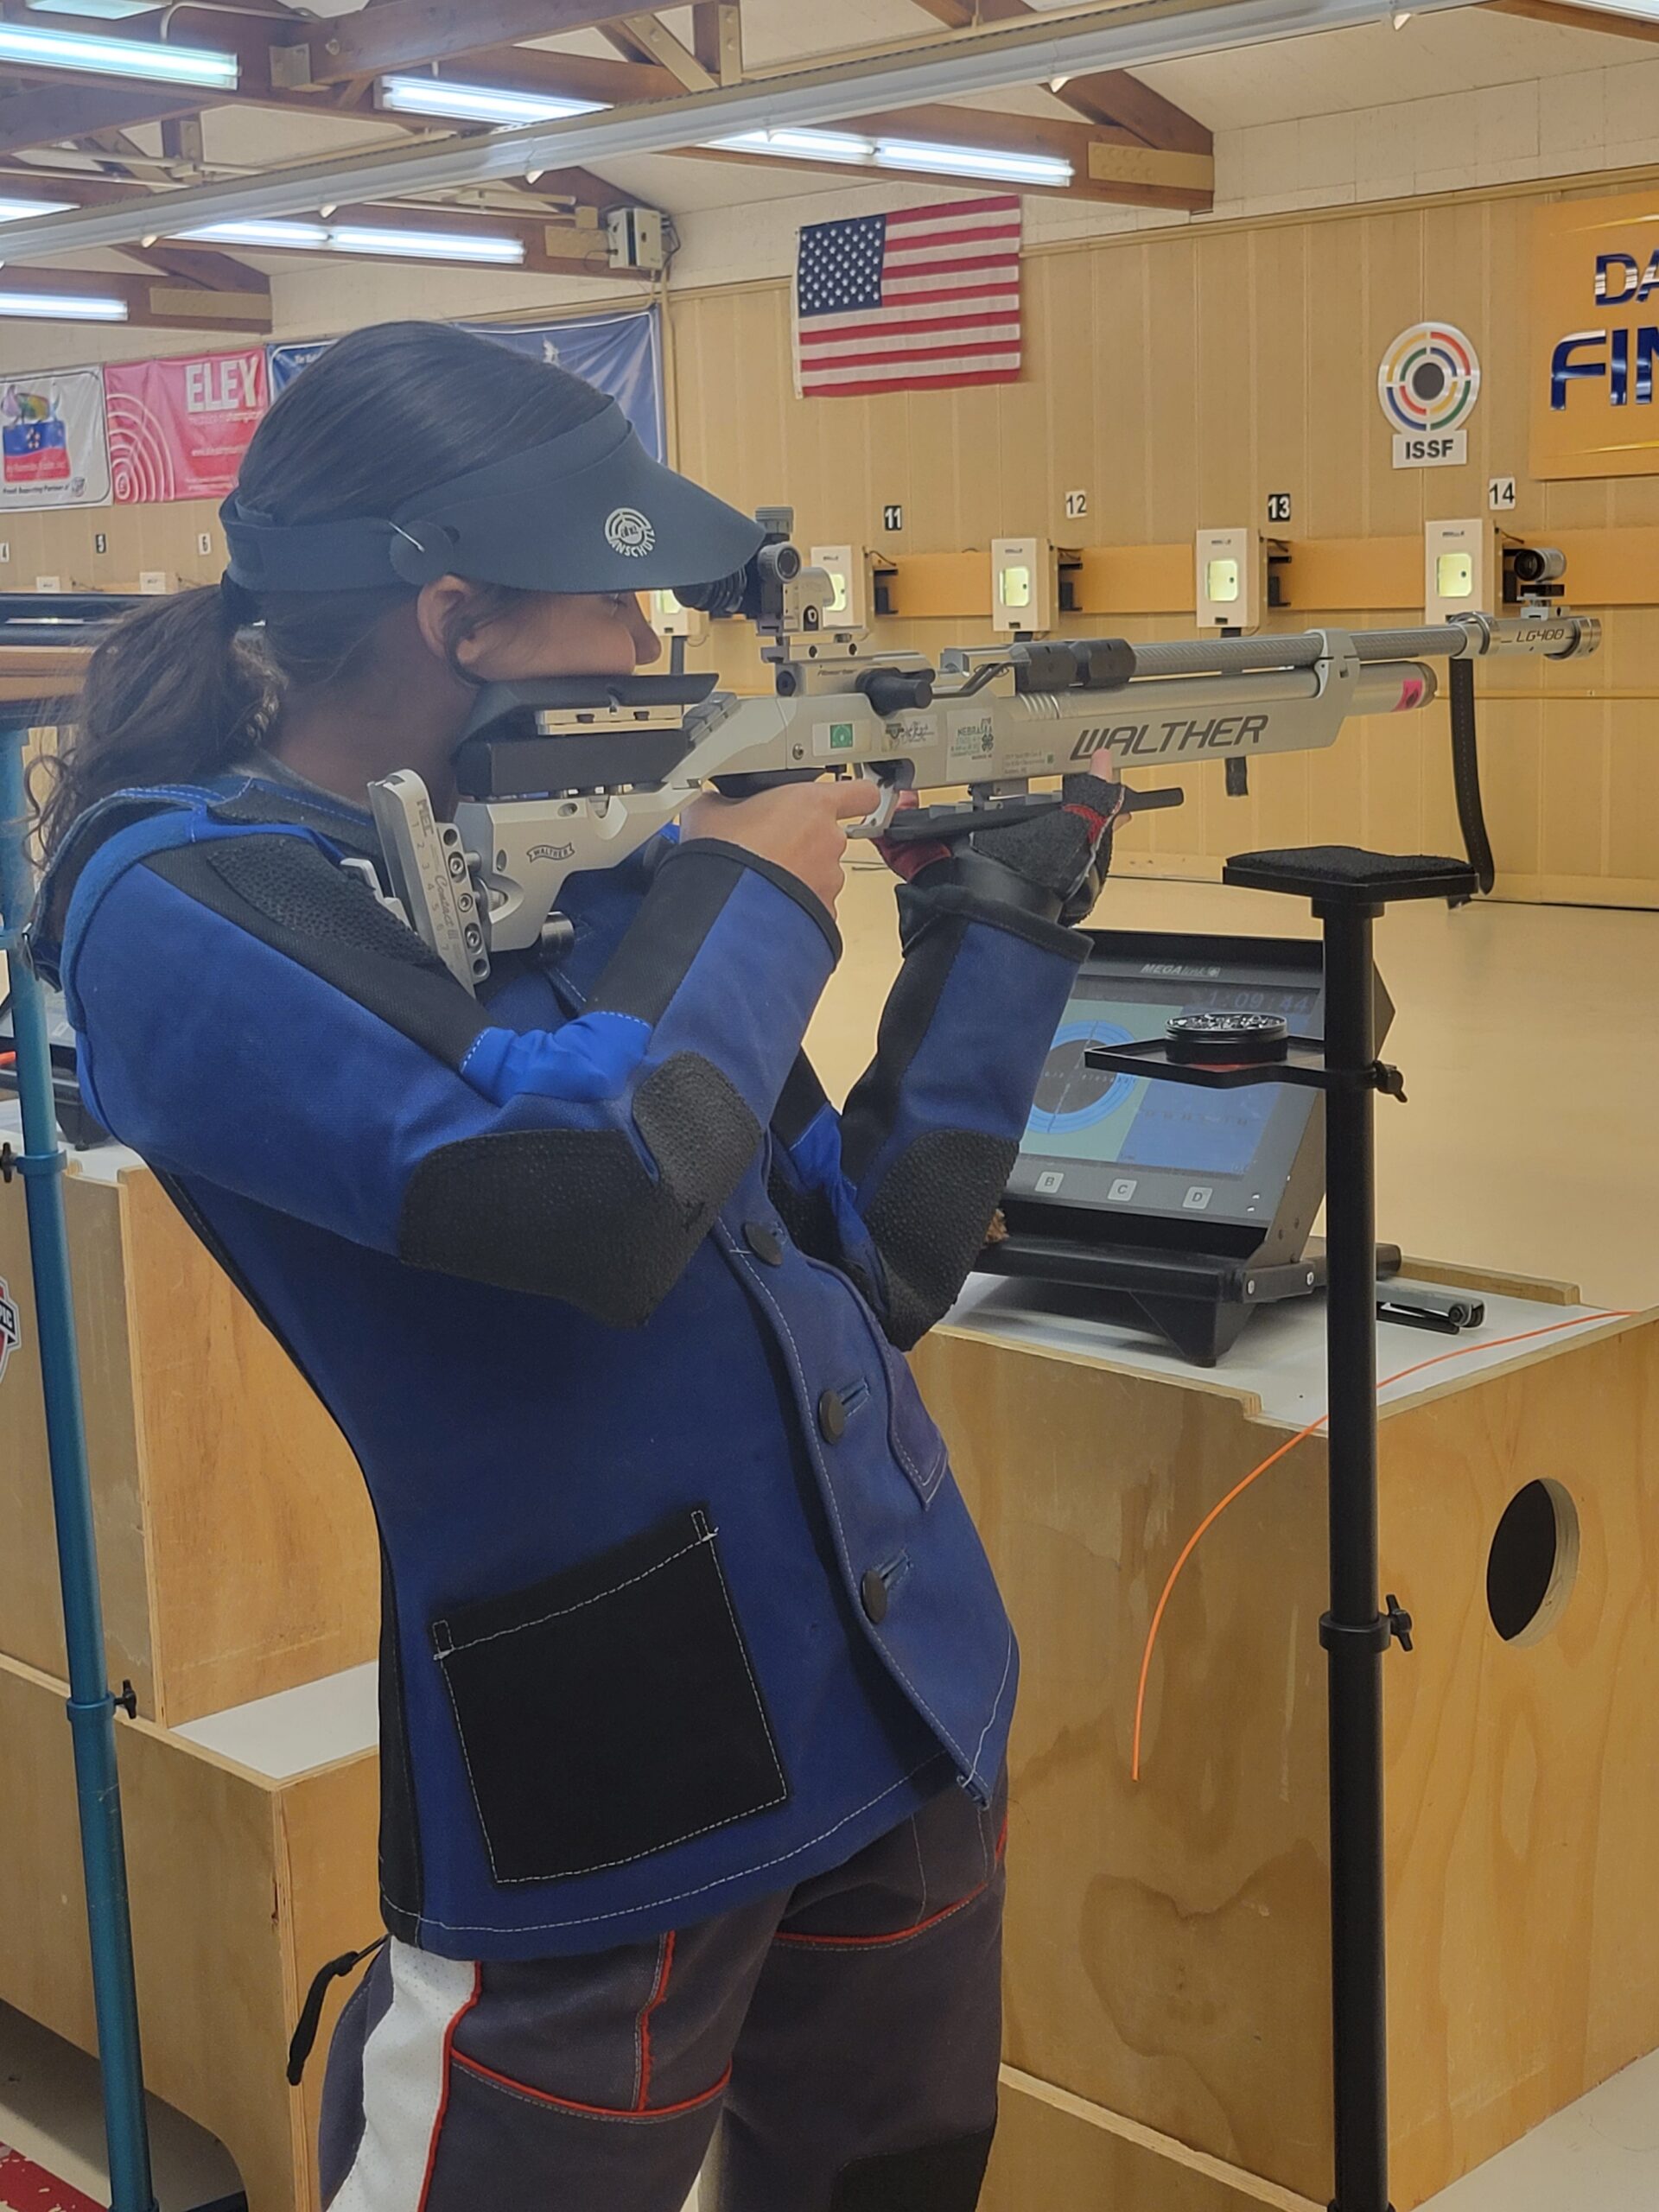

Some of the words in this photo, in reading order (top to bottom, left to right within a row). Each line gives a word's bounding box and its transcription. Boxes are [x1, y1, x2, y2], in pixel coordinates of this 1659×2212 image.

[186, 355, 257, 414] ELEY
[1405, 439, 1453, 460] ISSF
[1489, 482, 1515, 505] 14
[1066, 494, 1086, 515] 12
[1268, 496, 1290, 518] 13
[885, 507, 901, 529] 11
[1516, 629, 1565, 644] LG400
[1070, 715, 1268, 760] WALTHER
[1044, 1176, 1055, 1187] B
[1117, 1185, 1128, 1195] C
[1192, 1192, 1203, 1203] D
